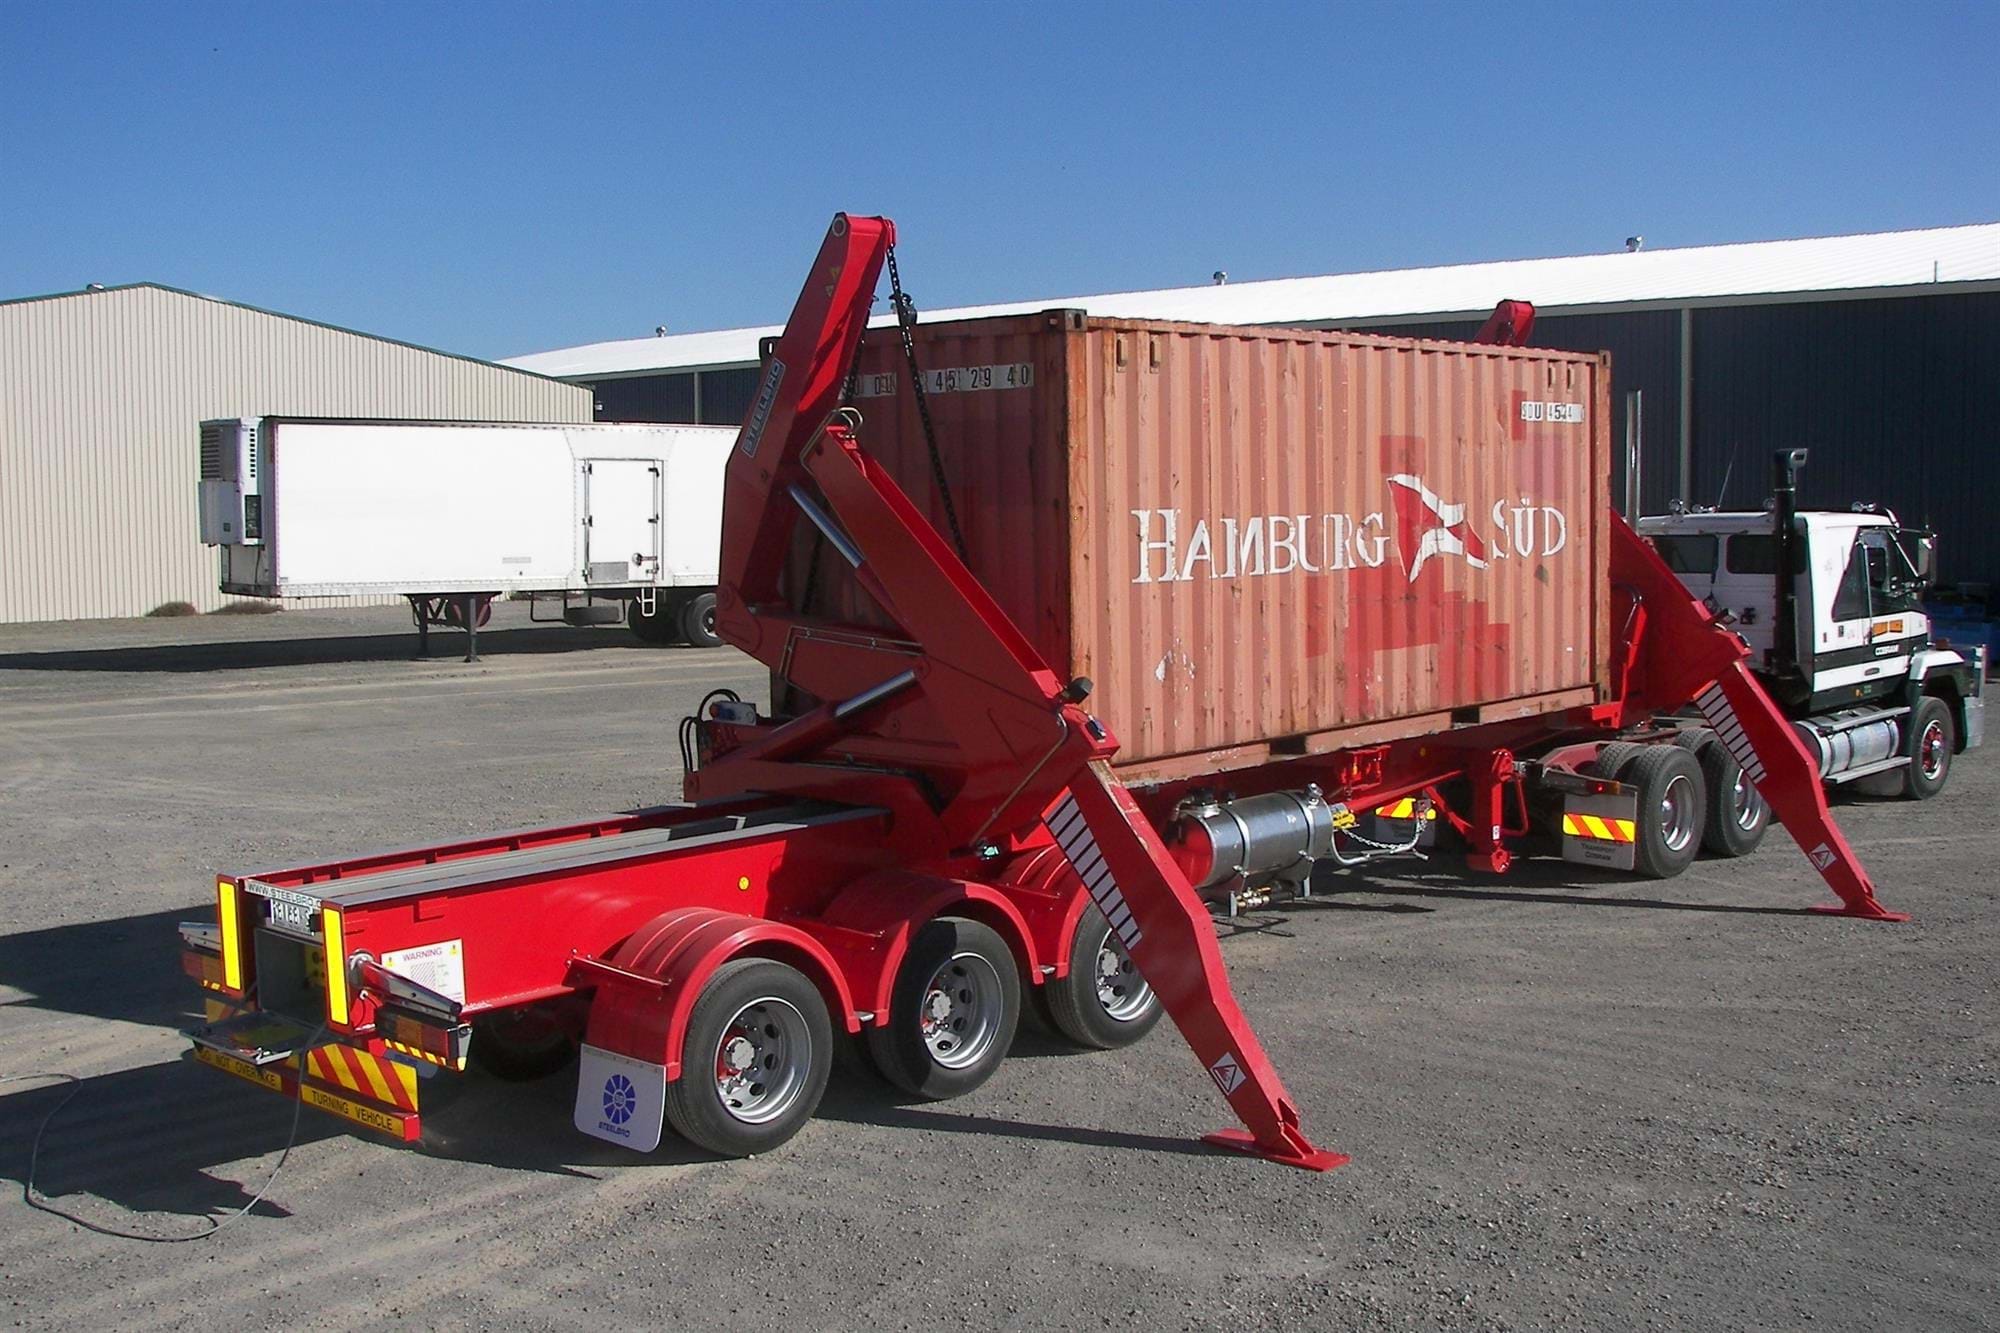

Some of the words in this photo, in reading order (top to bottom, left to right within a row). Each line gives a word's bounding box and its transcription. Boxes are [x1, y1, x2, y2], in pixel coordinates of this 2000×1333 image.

[1131, 509, 1390, 583] HAMBURG
[1492, 497, 1567, 560] SÜD
[402, 947, 442, 961] WARNING
[215, 1054, 230, 1070] NOT
[311, 1089, 349, 1114] TURNING
[354, 1105, 393, 1131] VEHICLE
